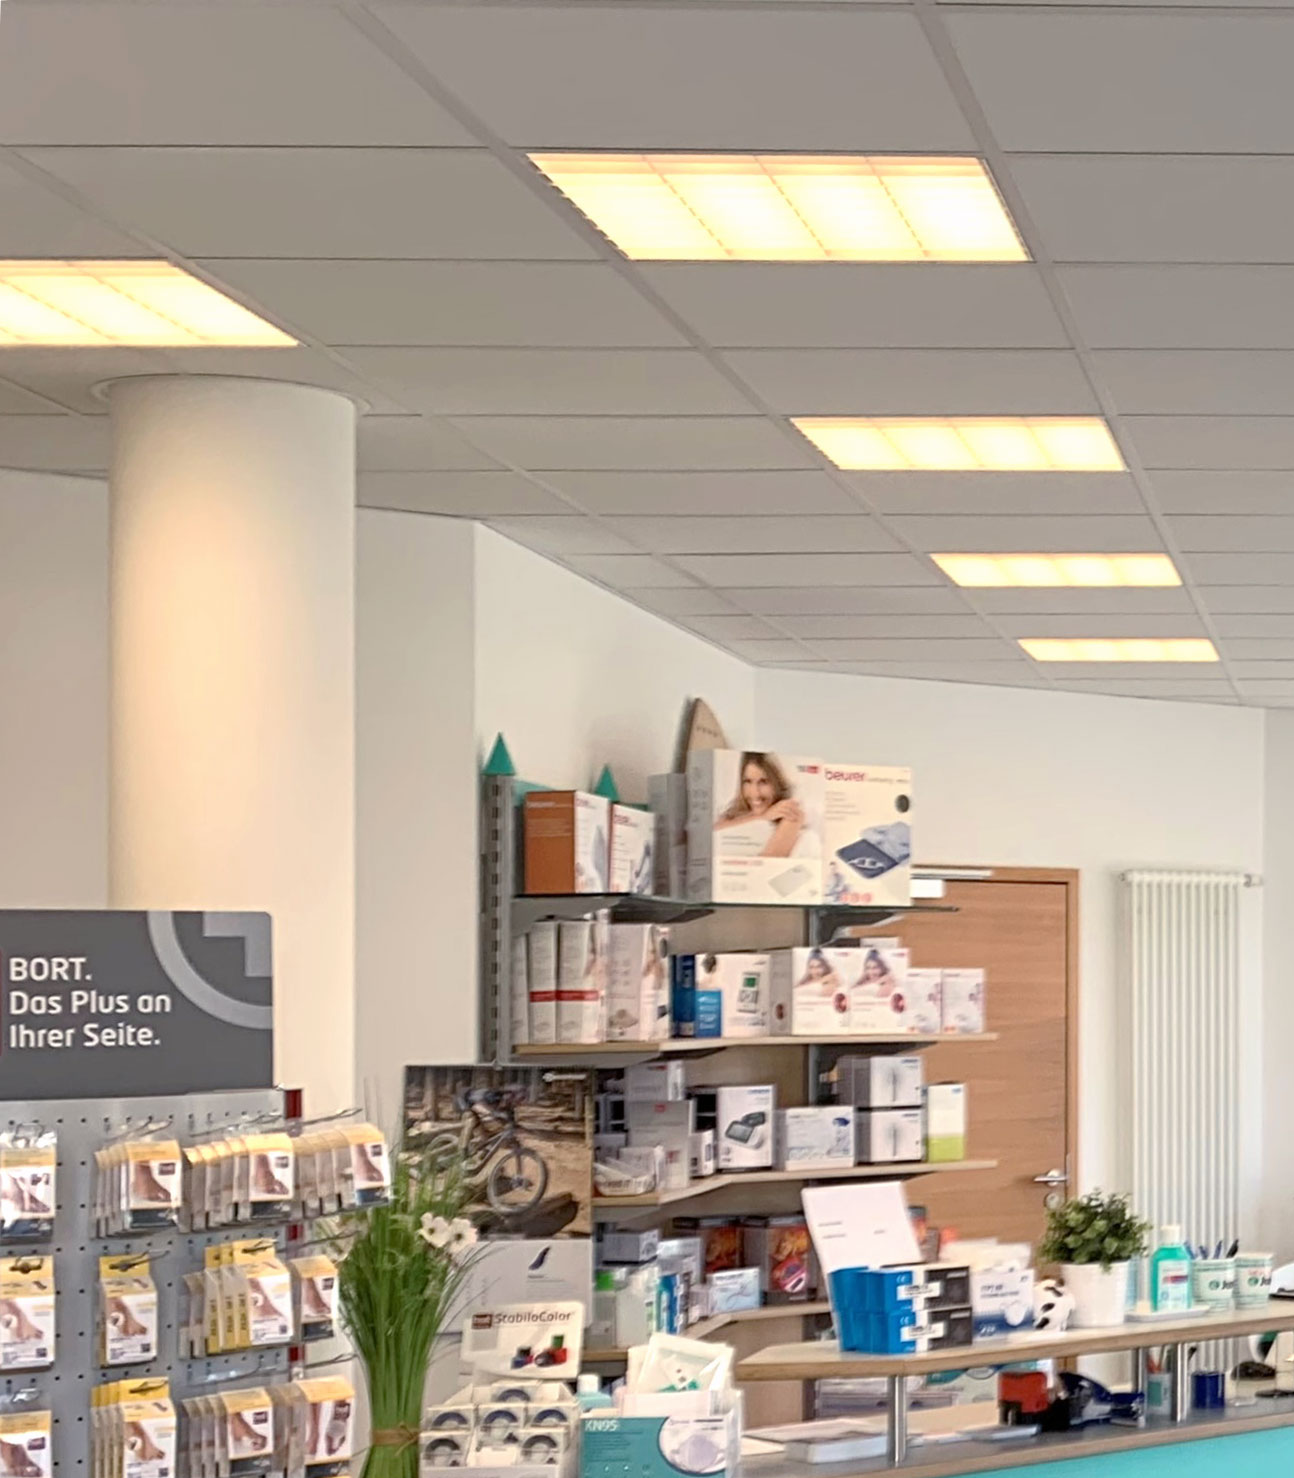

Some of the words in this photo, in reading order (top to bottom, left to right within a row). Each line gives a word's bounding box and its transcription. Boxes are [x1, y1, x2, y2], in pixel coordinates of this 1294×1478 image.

[9, 957, 92, 981] BORT.
[9, 991, 62, 1015] Das
[71, 991, 130, 1013] Plus
[137, 994, 171, 1012] an
[9, 1025, 74, 1047] Ihrer
[83, 1023, 160, 1047] Seite.
